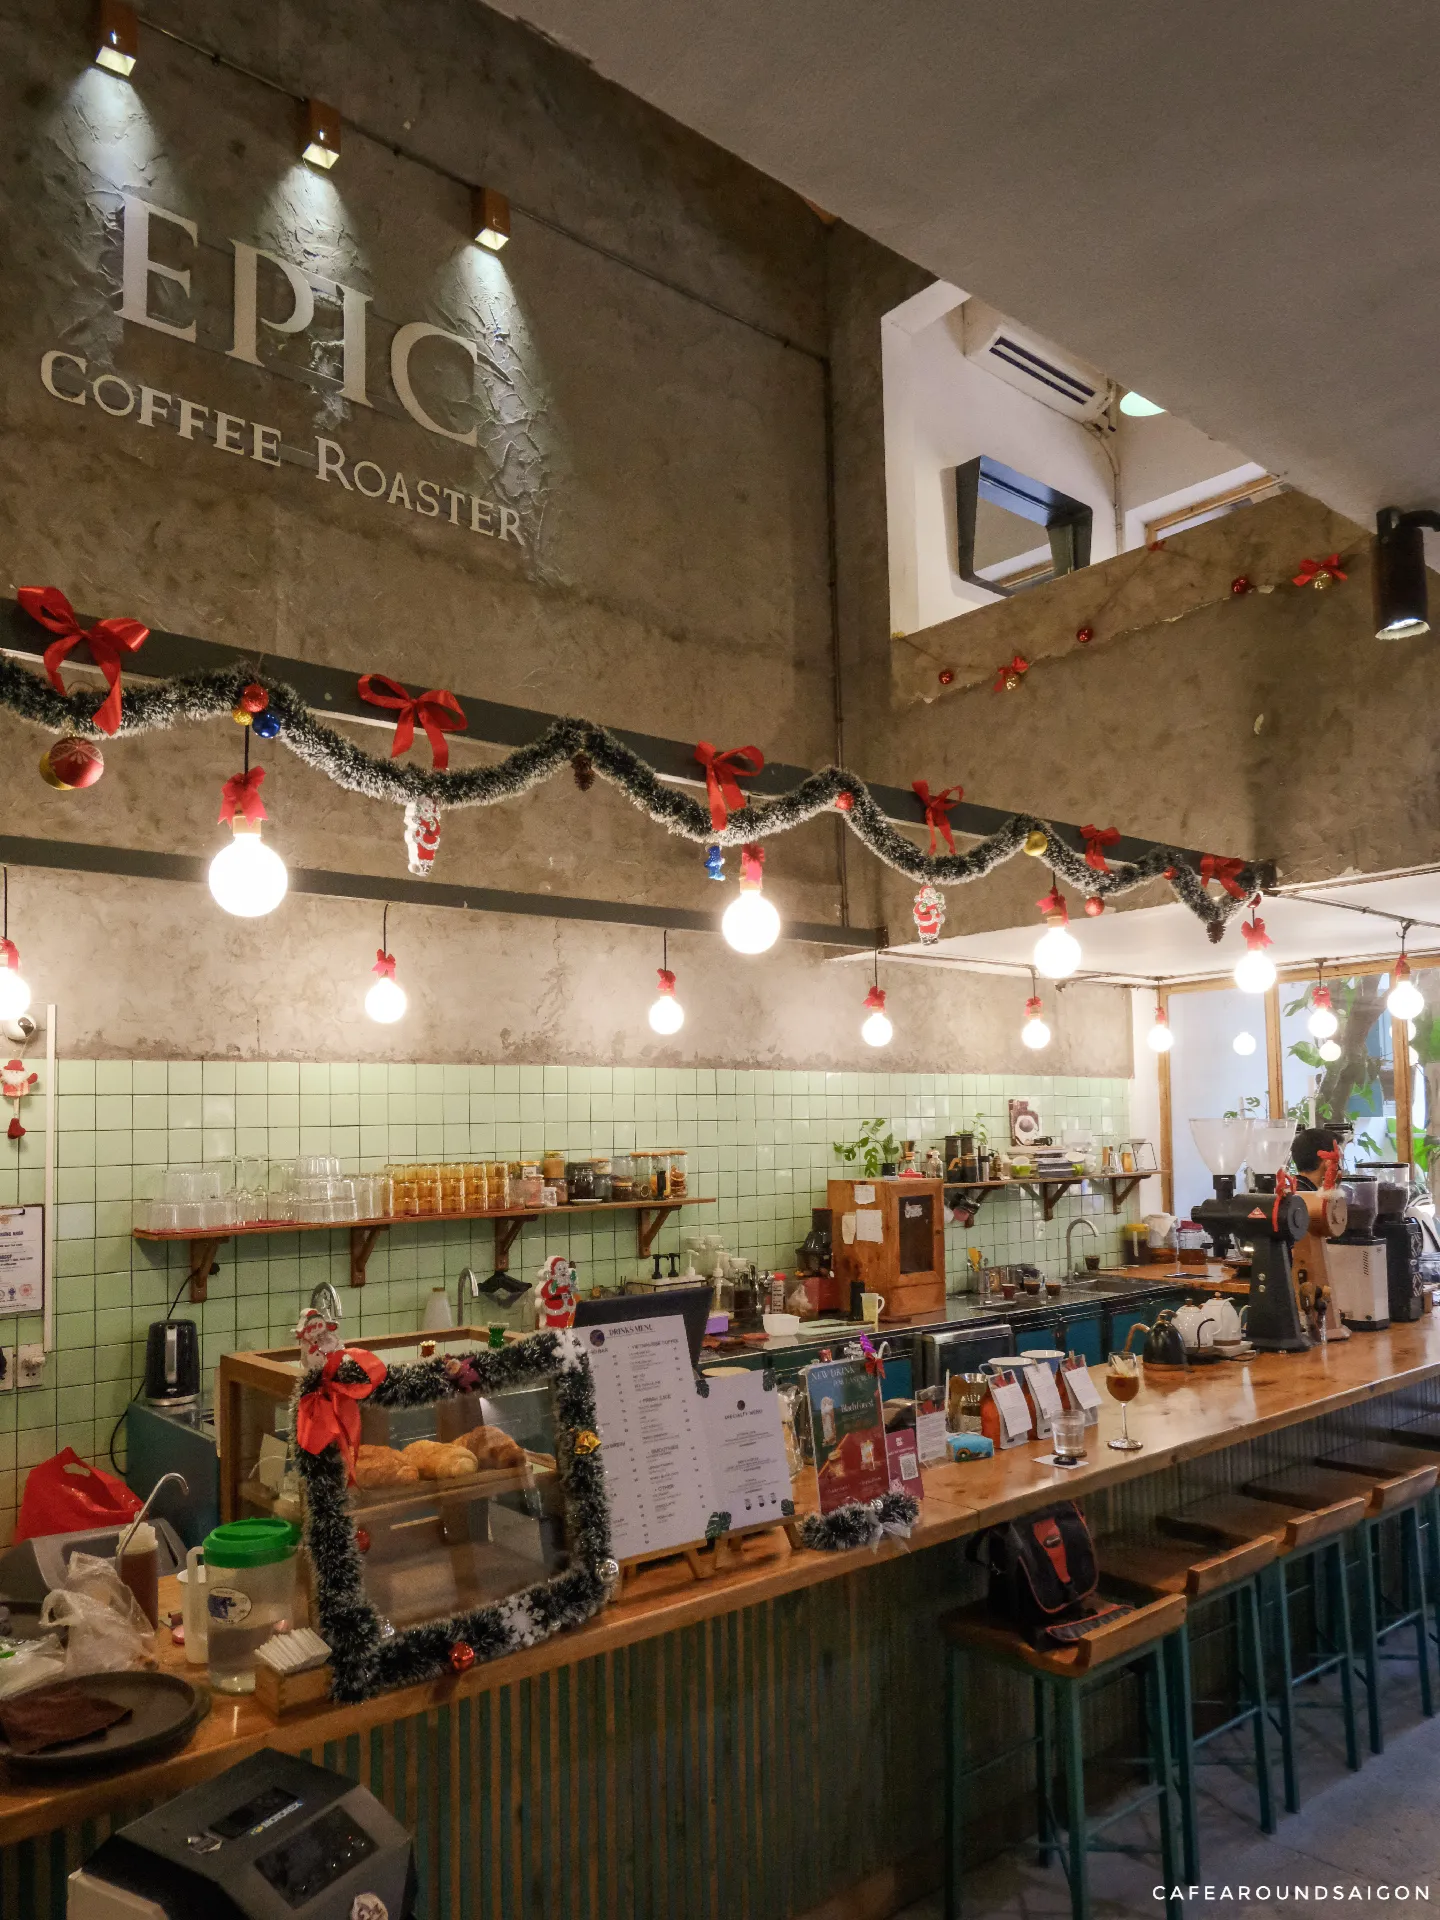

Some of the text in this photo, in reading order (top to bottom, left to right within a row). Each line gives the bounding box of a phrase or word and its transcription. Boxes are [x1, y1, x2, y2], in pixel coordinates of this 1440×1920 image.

[114, 192, 479, 447] EPIC
[40, 350, 526, 546] COFFEE ROASTER
[608, 1327, 634, 1336] DRINKS
[657, 1483, 675, 1492] OTHER
